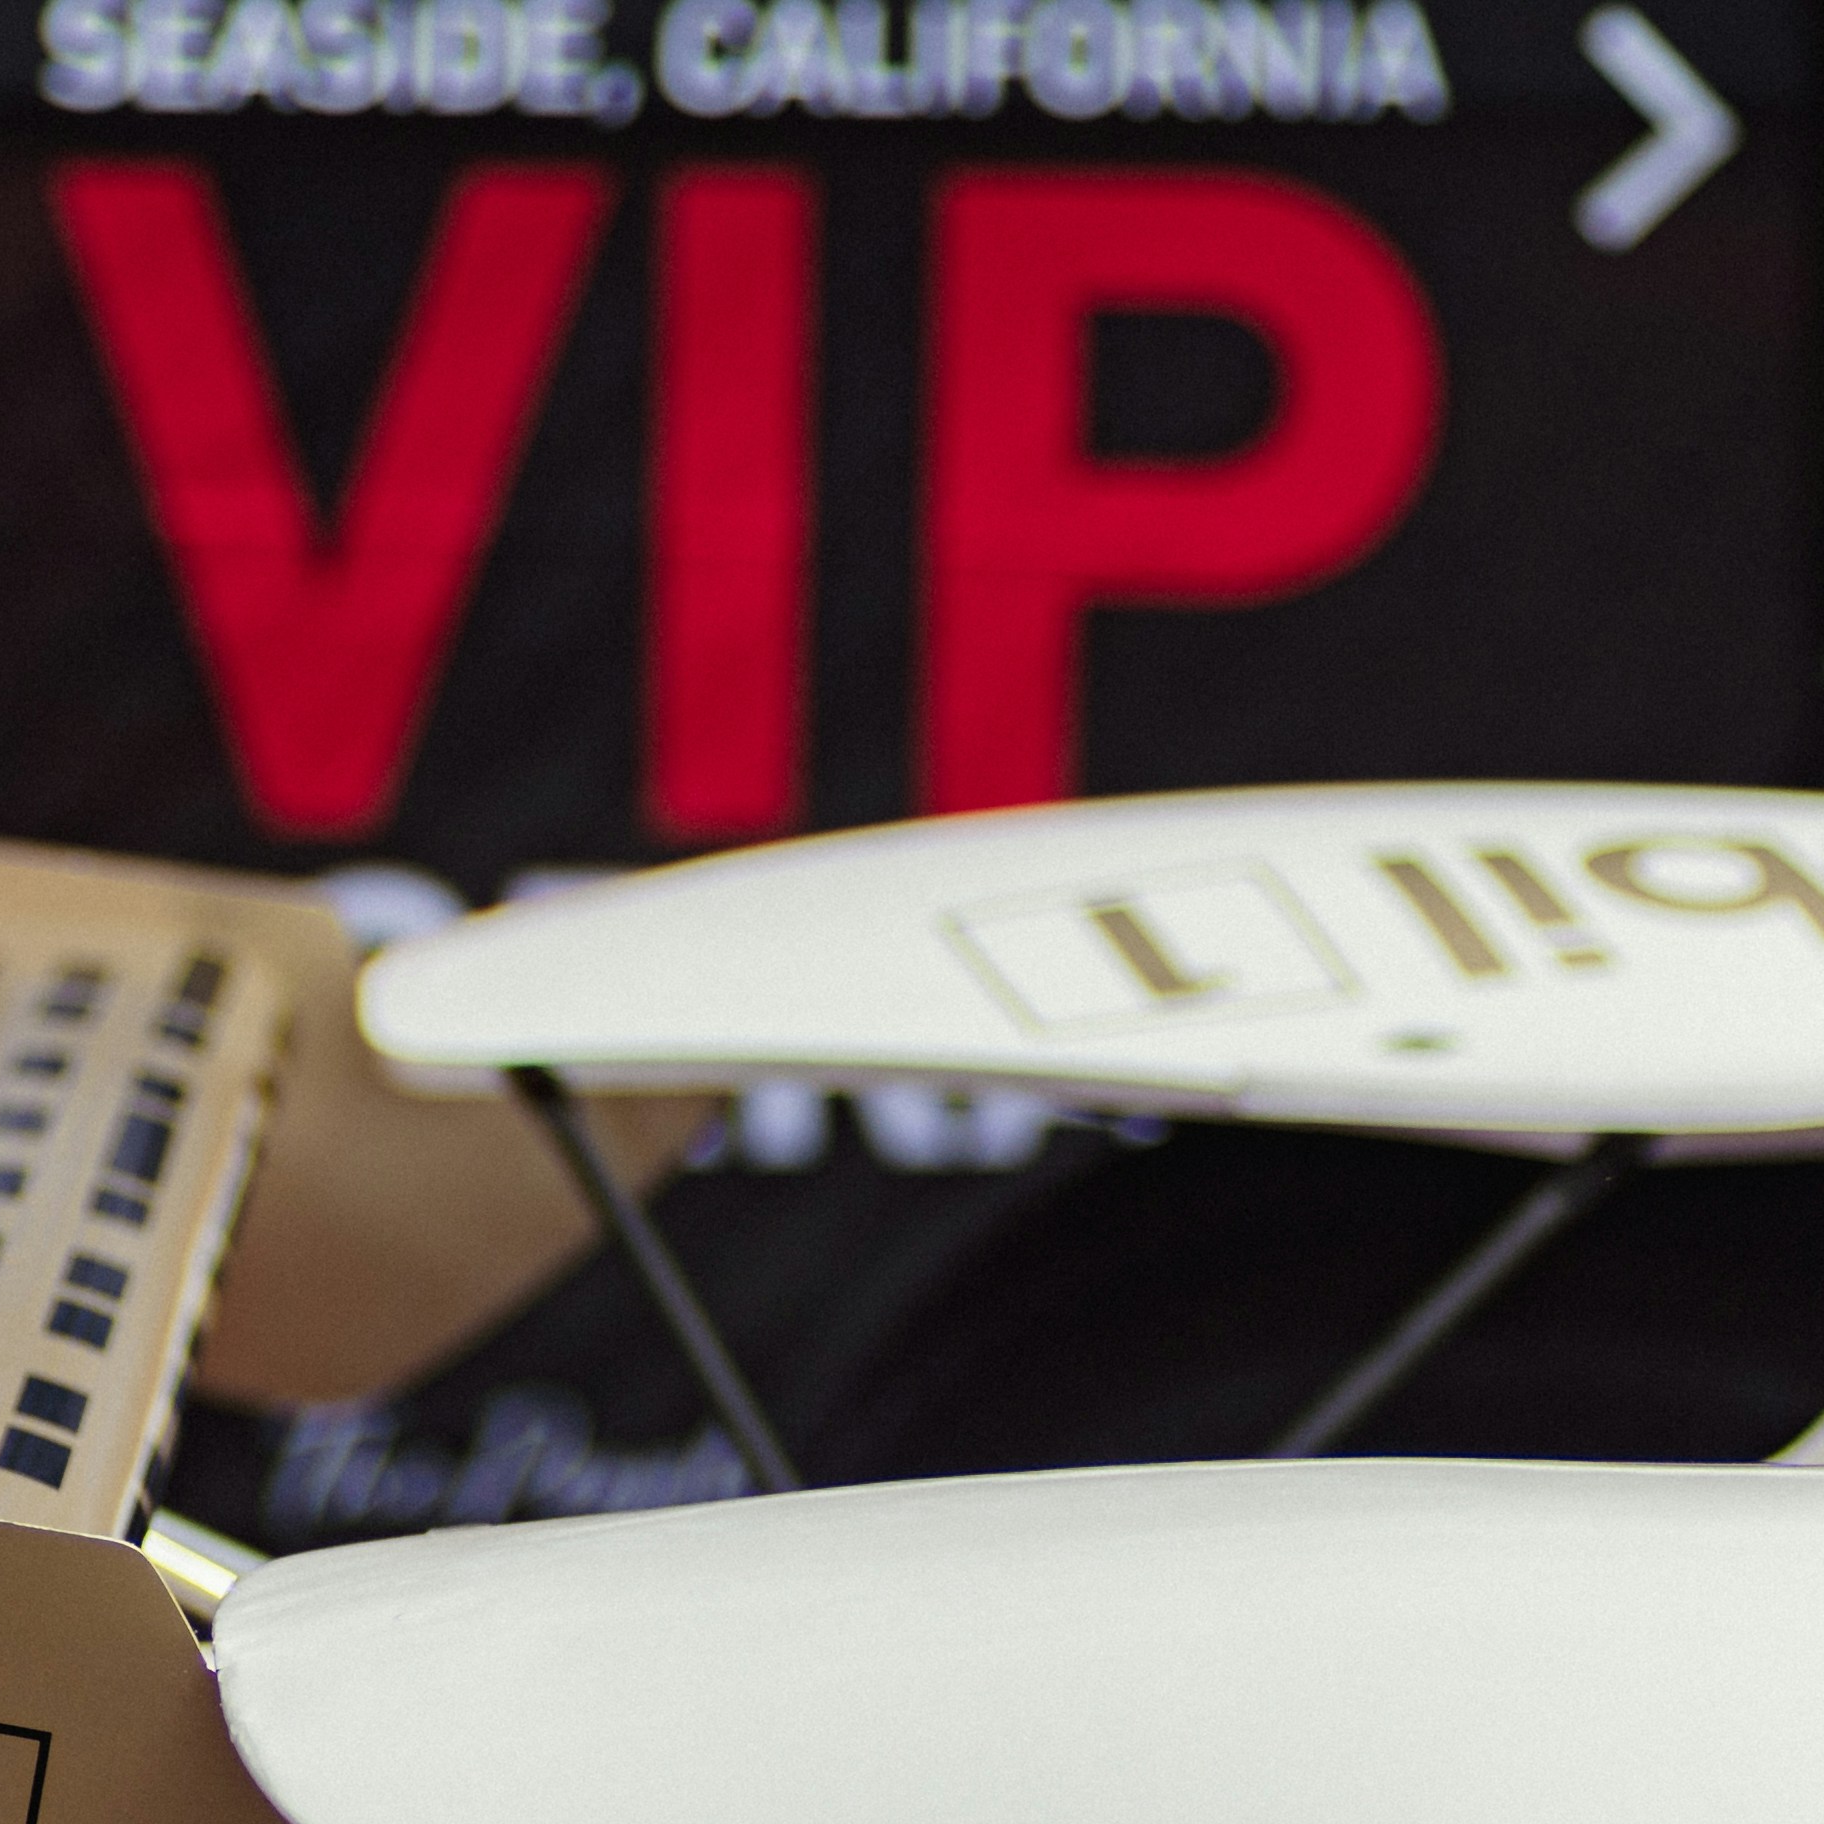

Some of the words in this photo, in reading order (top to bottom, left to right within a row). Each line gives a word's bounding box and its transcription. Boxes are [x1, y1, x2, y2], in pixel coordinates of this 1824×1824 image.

[38, 0, 646, 127] SEASIDE,
[654, 0, 1452, 122] CALIFORNIA
[44, 152, 1448, 845] VIP
[1083, 892, 1233, 1003] 1
